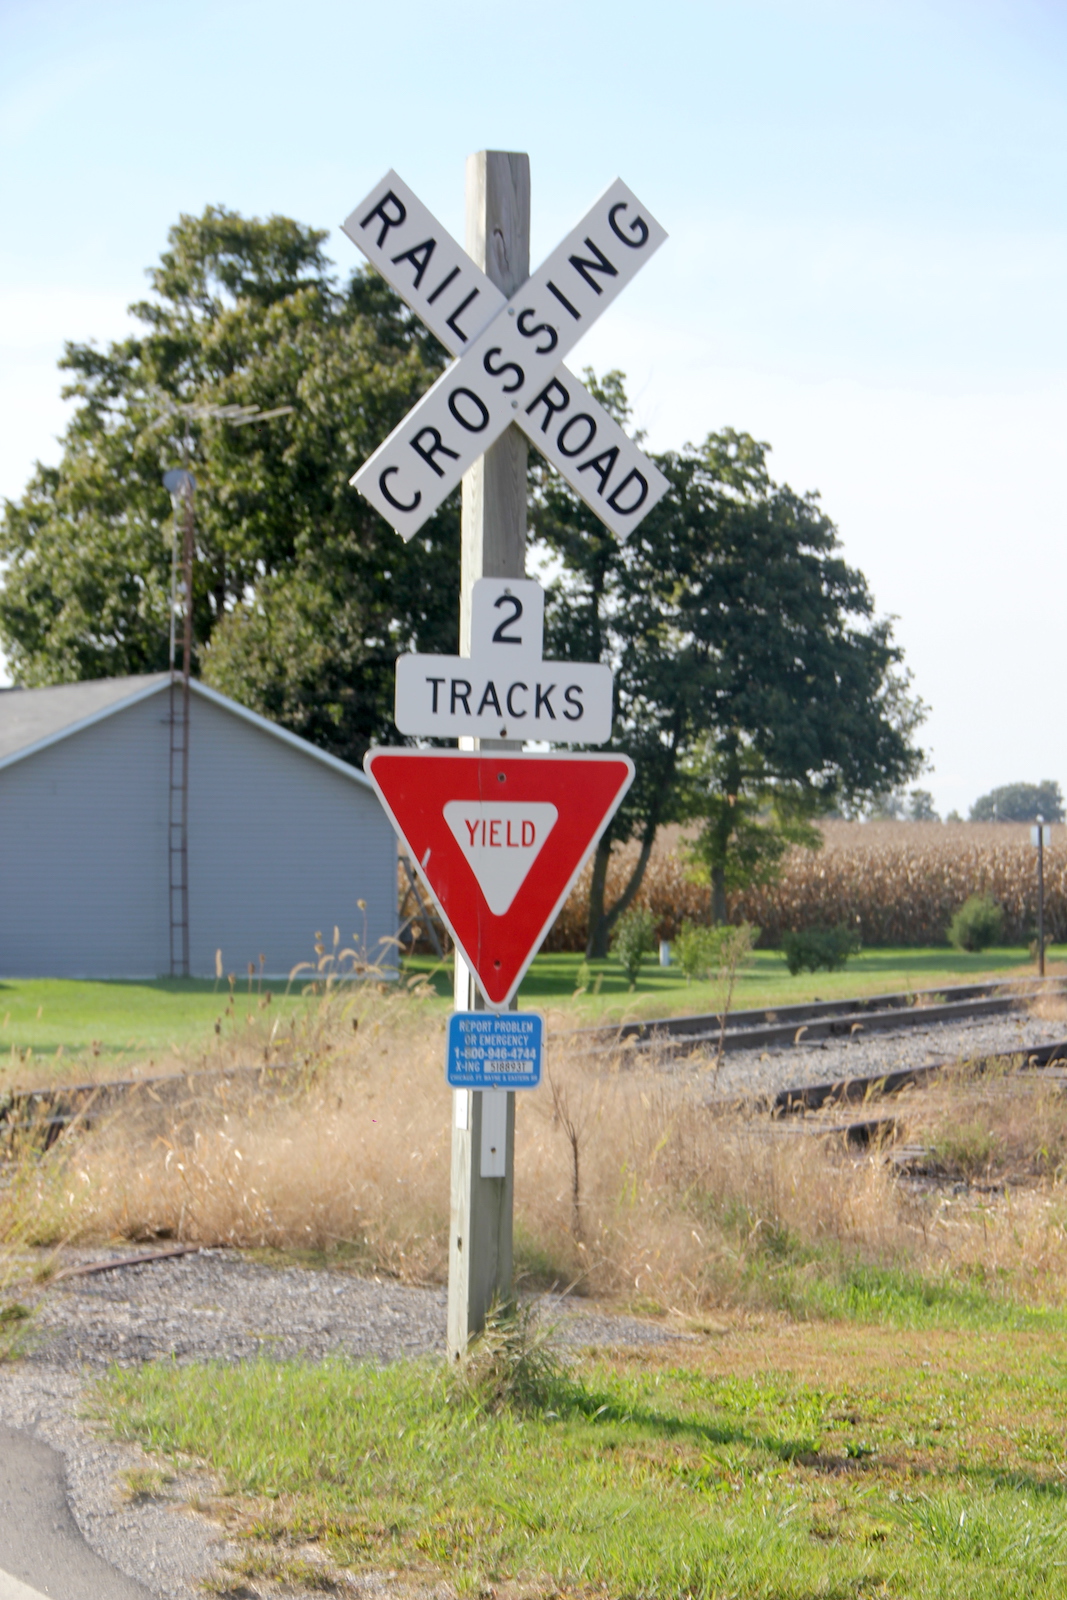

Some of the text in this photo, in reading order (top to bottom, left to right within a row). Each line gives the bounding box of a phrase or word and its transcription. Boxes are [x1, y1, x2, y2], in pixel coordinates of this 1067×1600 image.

[359, 189, 480, 343] RAIL
[378, 202, 650, 514] CROSSING
[525, 376, 649, 516] ROAD
[492, 595, 523, 645] 2
[425, 677, 584, 721] TRACKS
[464, 819, 536, 848] YIELD
[459, 1020, 533, 1032] REPORT PROBLEM
[465, 1034, 529, 1046] OR EMERGENCY
[454, 1047, 536, 1059] 1-800-946-4744
[456, 1061, 480, 1072] X-ING
